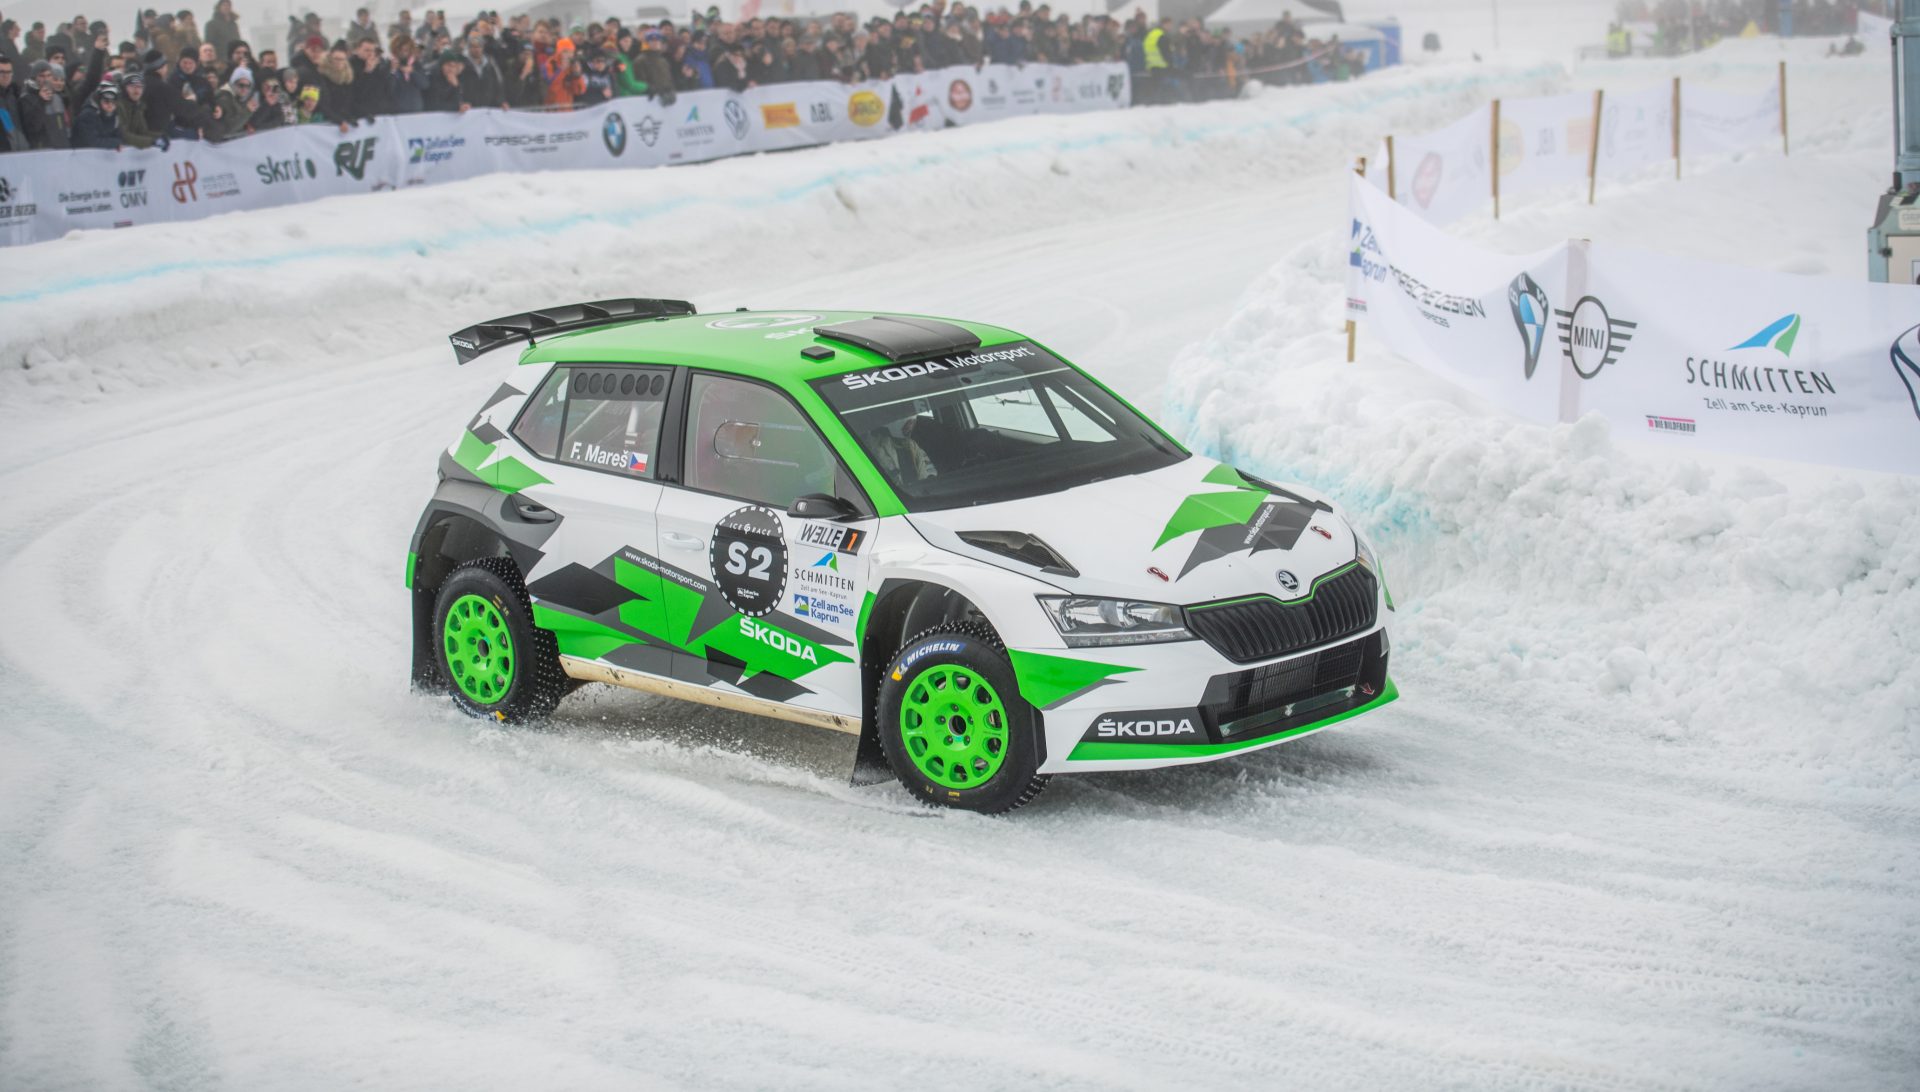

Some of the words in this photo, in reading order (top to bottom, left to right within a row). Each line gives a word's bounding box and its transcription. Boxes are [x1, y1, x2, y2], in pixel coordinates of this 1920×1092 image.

[484, 135, 546, 146] PORSCHE
[549, 131, 588, 144] DESIGN
[334, 137, 380, 181] RUF
[120, 191, 148, 209] OMV
[453, 338, 474, 350] ŠKODA
[1574, 325, 1604, 350] MINI
[841, 361, 949, 390] ŠKODA
[946, 345, 1035, 369] Motorsport
[1686, 357, 1836, 395] SCHMITTEN
[1703, 397, 1725, 410] Zell
[1731, 401, 1750, 412] am
[570, 441, 582, 460] F.
[585, 444, 629, 468] Mareš
[729, 522, 743, 531] ICE
[752, 528, 772, 536] RACE
[847, 531, 858, 551] 1
[625, 550, 707, 591] www.skoda-motorsport.com
[724, 541, 773, 581] S2
[794, 568, 854, 592] SCHMITTEN
[811, 597, 826, 610] Zell
[826, 604, 838, 612] am
[839, 604, 854, 616] See
[811, 608, 840, 623] Kaprun
[739, 616, 818, 665] ŠKODA
[906, 642, 960, 665] MICHELIN
[1097, 718, 1195, 737] ŠKODA
